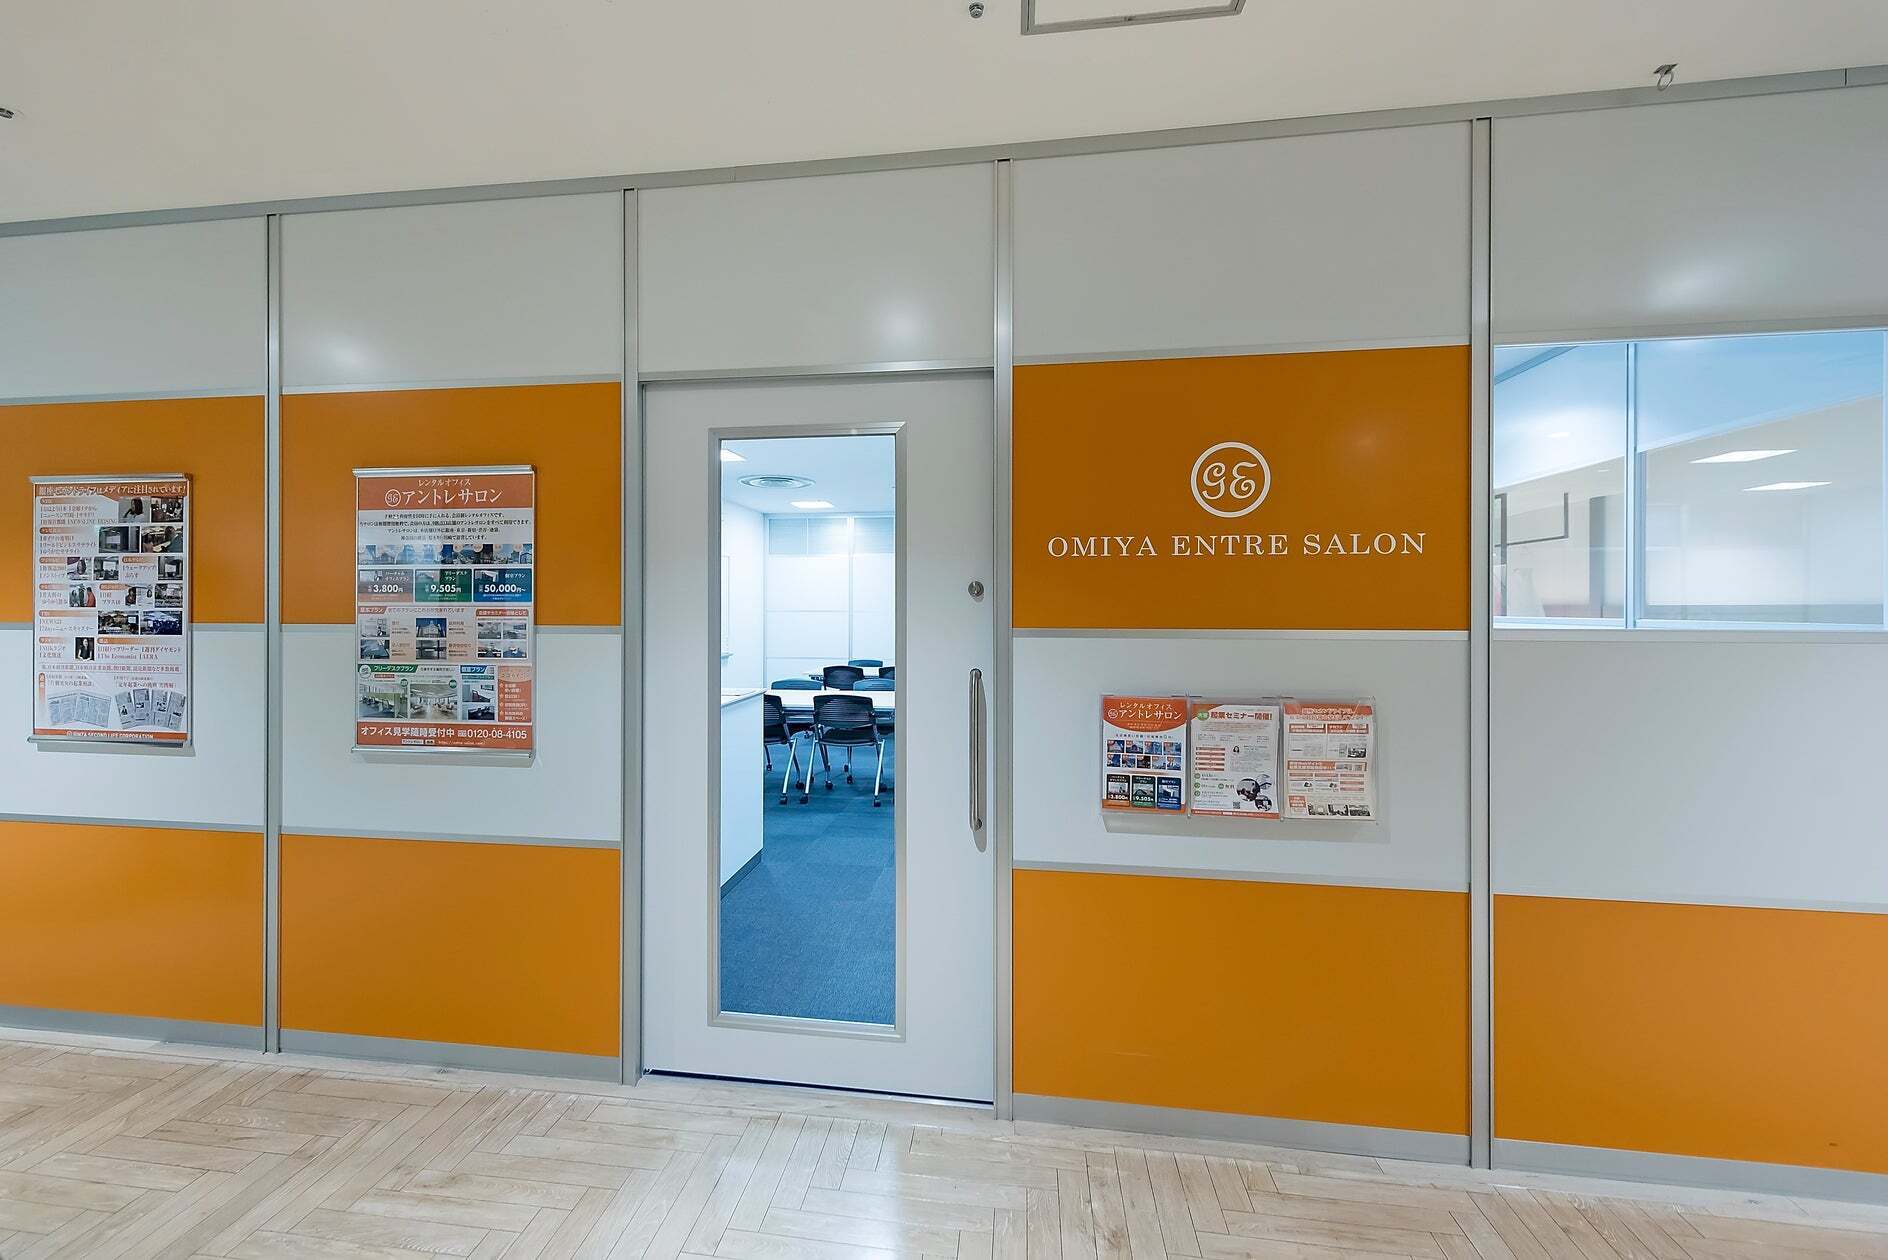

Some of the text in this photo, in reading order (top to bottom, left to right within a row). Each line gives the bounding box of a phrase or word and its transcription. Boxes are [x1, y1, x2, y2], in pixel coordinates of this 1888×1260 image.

[418, 478, 472, 487] レンタルオフィス
[401, 488, 503, 505] アントレサロン
[1047, 532, 1427, 557] OMIYA ENTRE SALON
[1120, 702, 1173, 710] レンタルオフィス
[1119, 709, 1182, 720] アントレサロン
[361, 726, 455, 738] オフィス見学随時受付中
[467, 729, 527, 740] 0120-08-4105
